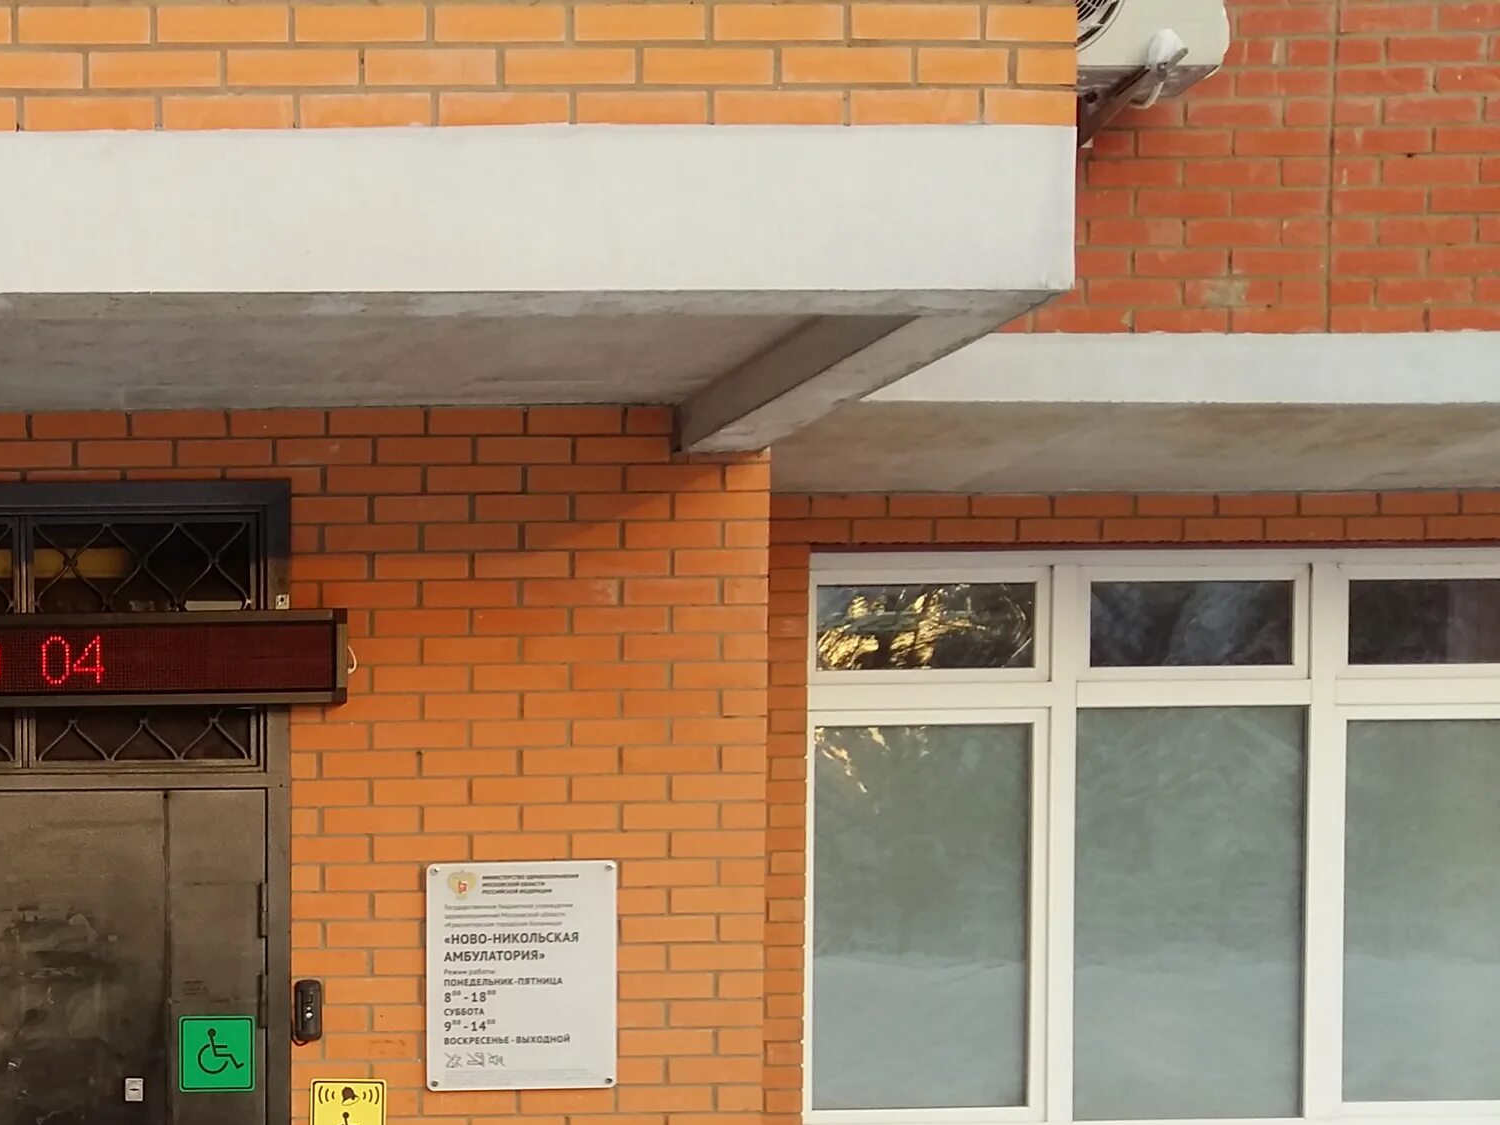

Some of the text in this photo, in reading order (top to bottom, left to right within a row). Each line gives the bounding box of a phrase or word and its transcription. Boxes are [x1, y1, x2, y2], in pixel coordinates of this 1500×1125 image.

[41, 635, 104, 686] 04
[444, 932, 579, 945] «НОВО-НИКОЛЬСКАЯ
[444, 950, 545, 963] АМБУЛАТОРИЯ»
[444, 977, 563, 987] ПОНЕДЕЛЬНИК-ПЯТНИЦА
[444, 1008, 485, 1016] СУББОТА
[444, 1036, 509, 1045] ВОСКРЕСЕНЬЕ
[516, 1034, 570, 1044] ВЫХОДНОЙ
